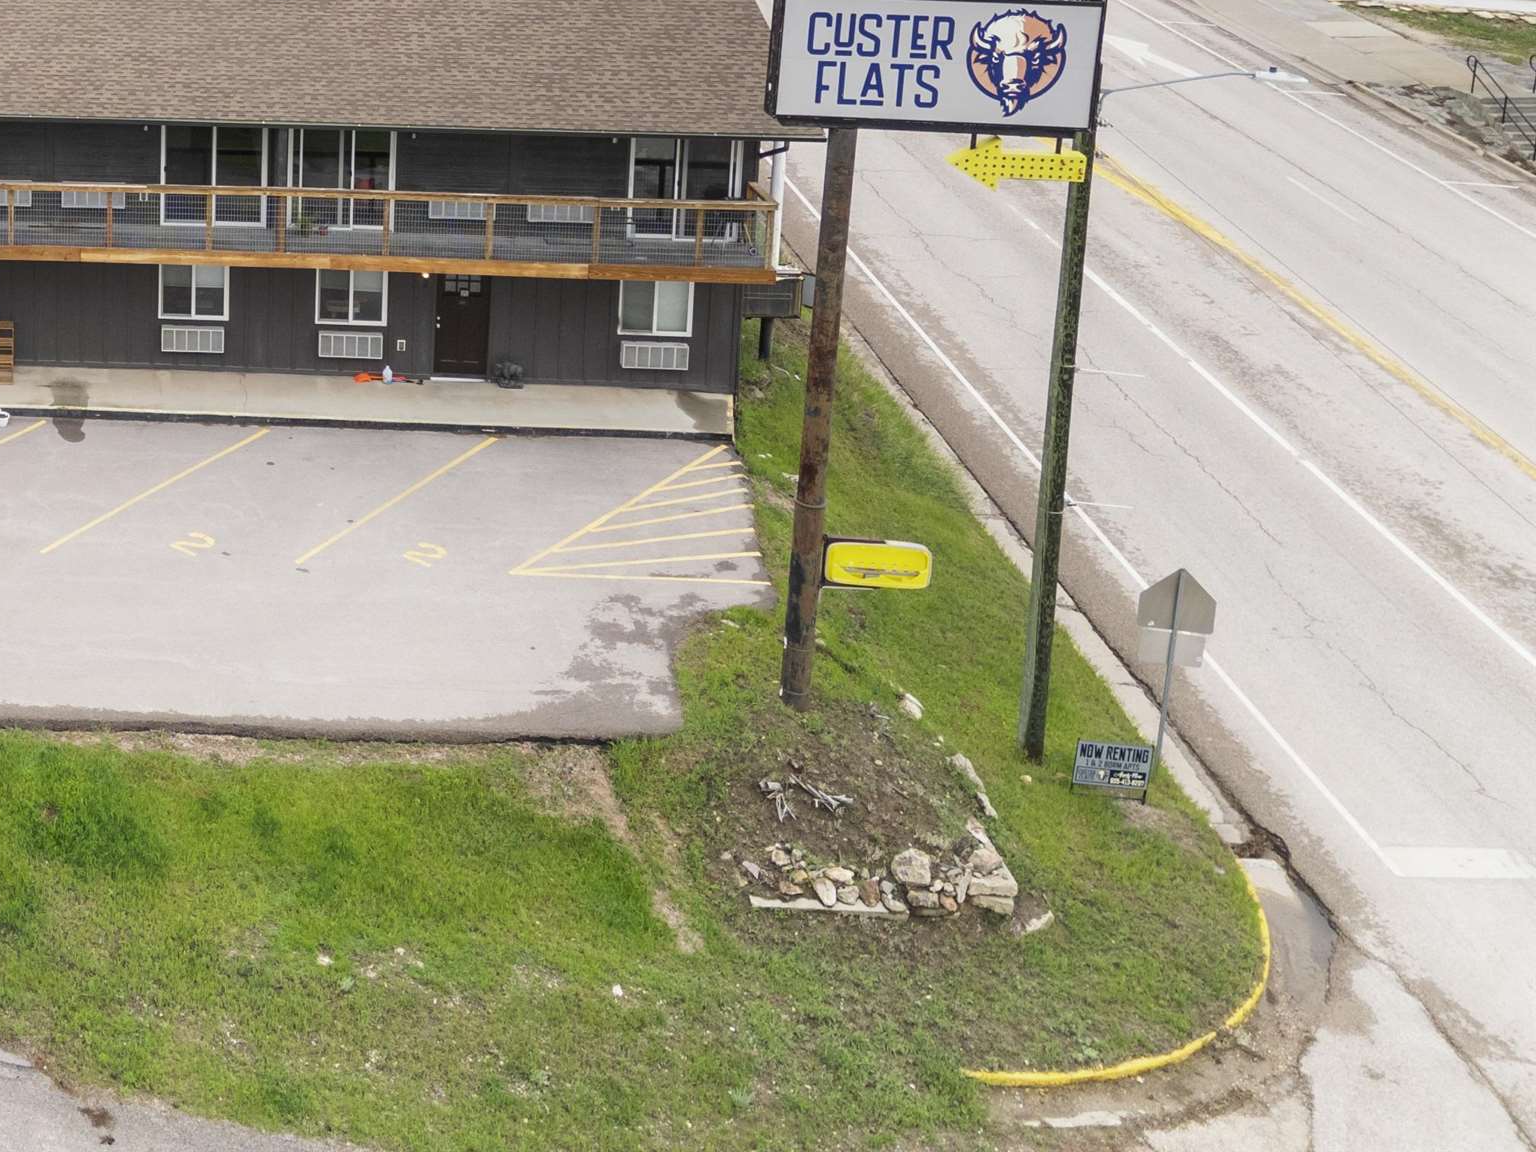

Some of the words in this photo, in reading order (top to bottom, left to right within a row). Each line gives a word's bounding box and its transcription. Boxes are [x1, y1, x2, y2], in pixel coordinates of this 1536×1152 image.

[807, 11, 955, 60] CUSTER
[814, 60, 941, 108] FLATS
[169, 532, 215, 557] 2
[402, 541, 448, 567] 2
[1080, 744, 1104, 758] NOW
[1106, 746, 1149, 763] RENTING
